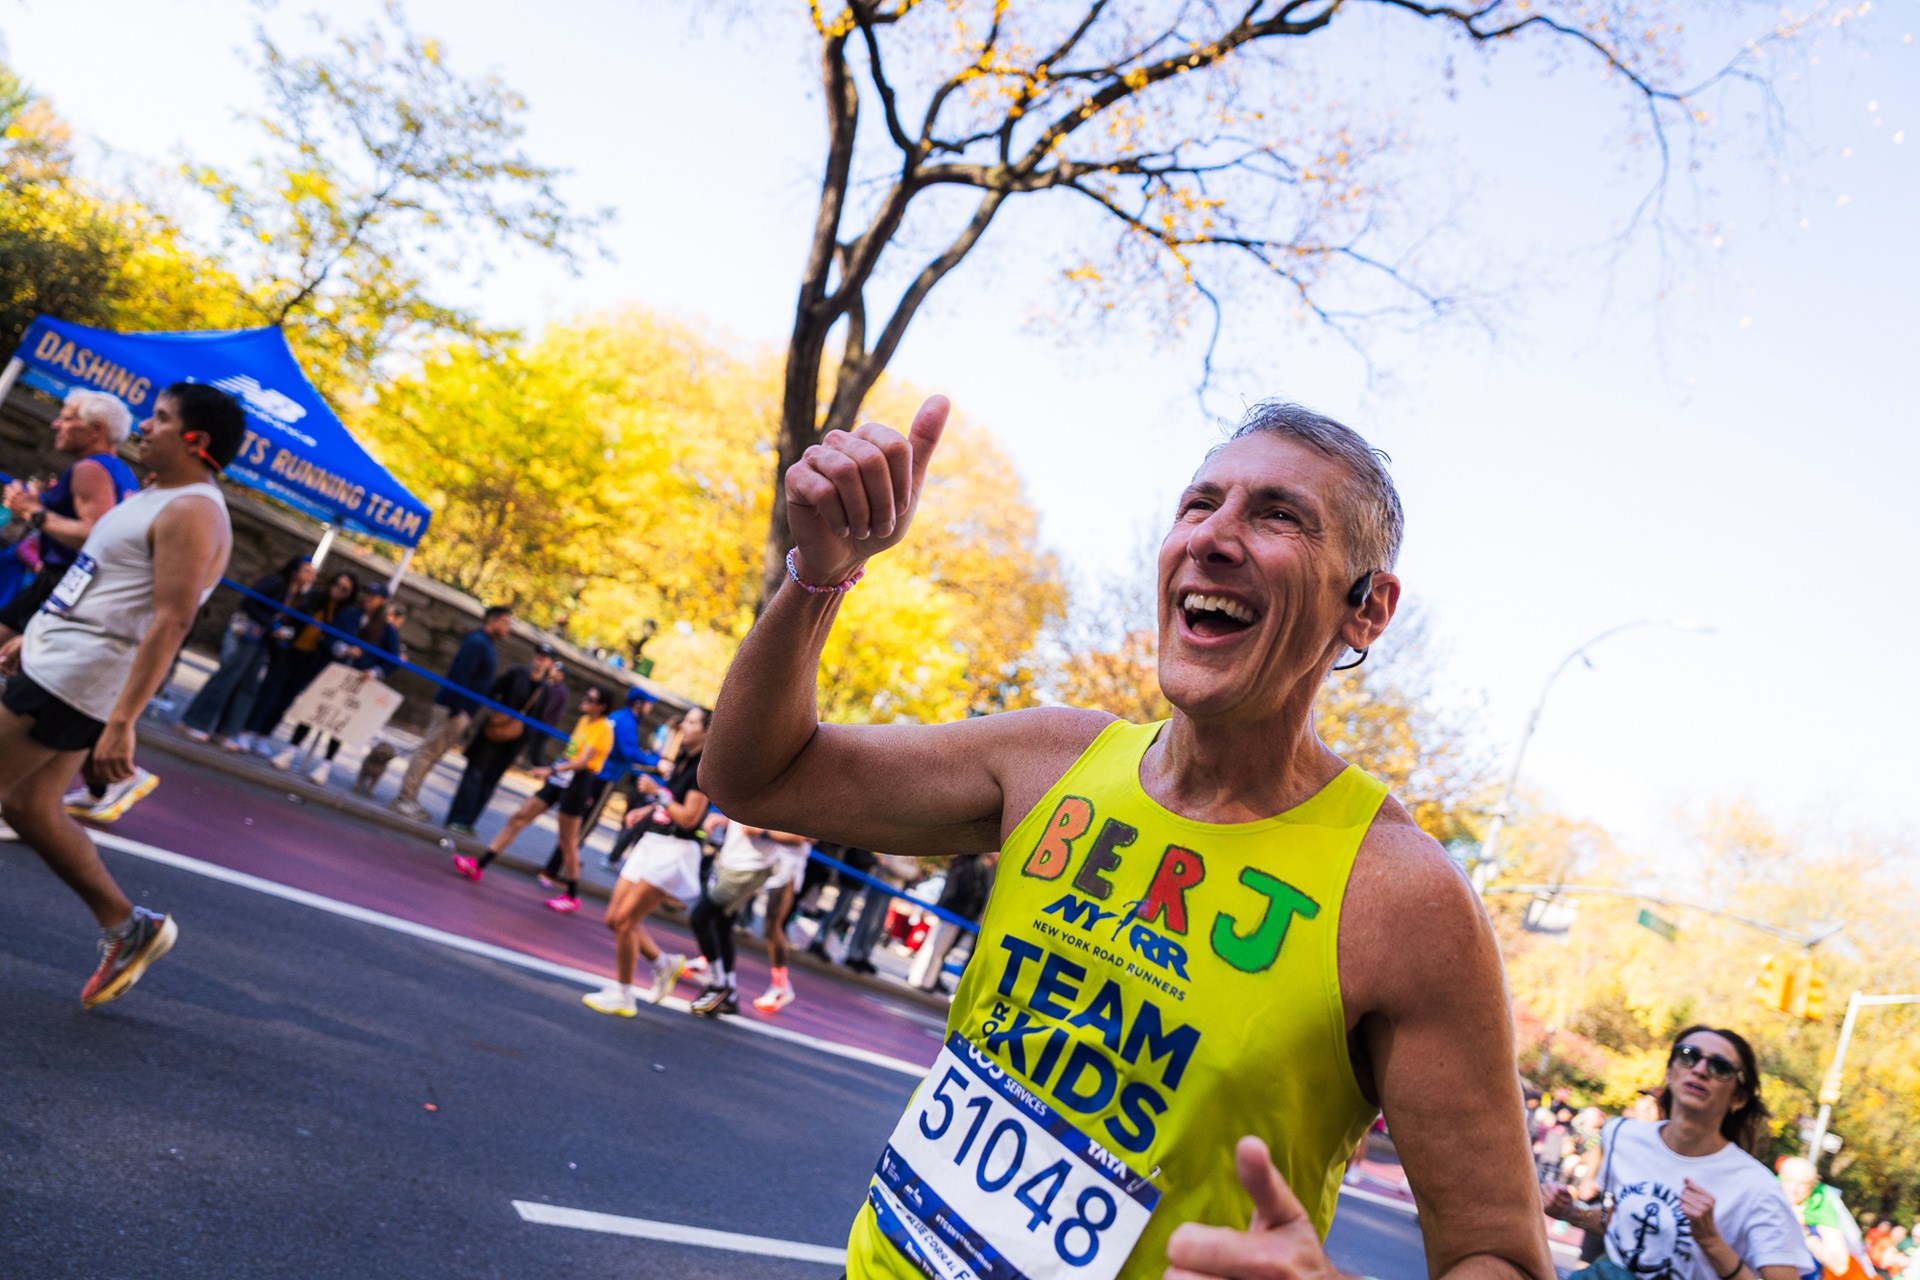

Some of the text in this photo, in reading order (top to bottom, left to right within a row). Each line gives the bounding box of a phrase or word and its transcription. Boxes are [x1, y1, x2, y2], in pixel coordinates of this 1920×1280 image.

[34, 330, 151, 406] DASHING
[271, 448, 365, 511] RUNNING
[366, 493, 422, 539] TEAM
[1021, 794, 1321, 973] BERJ
[1032, 919, 1186, 1001] NEW YORK ROAD RUNNERS
[979, 1001, 1012, 1040] OR
[1000, 934, 1201, 1092] TEAM
[986, 1010, 1168, 1154] KIDS
[1003, 1077, 1048, 1117] SERVICES
[918, 1065, 1118, 1268] 51048
[1087, 1138, 1127, 1180] TATA
